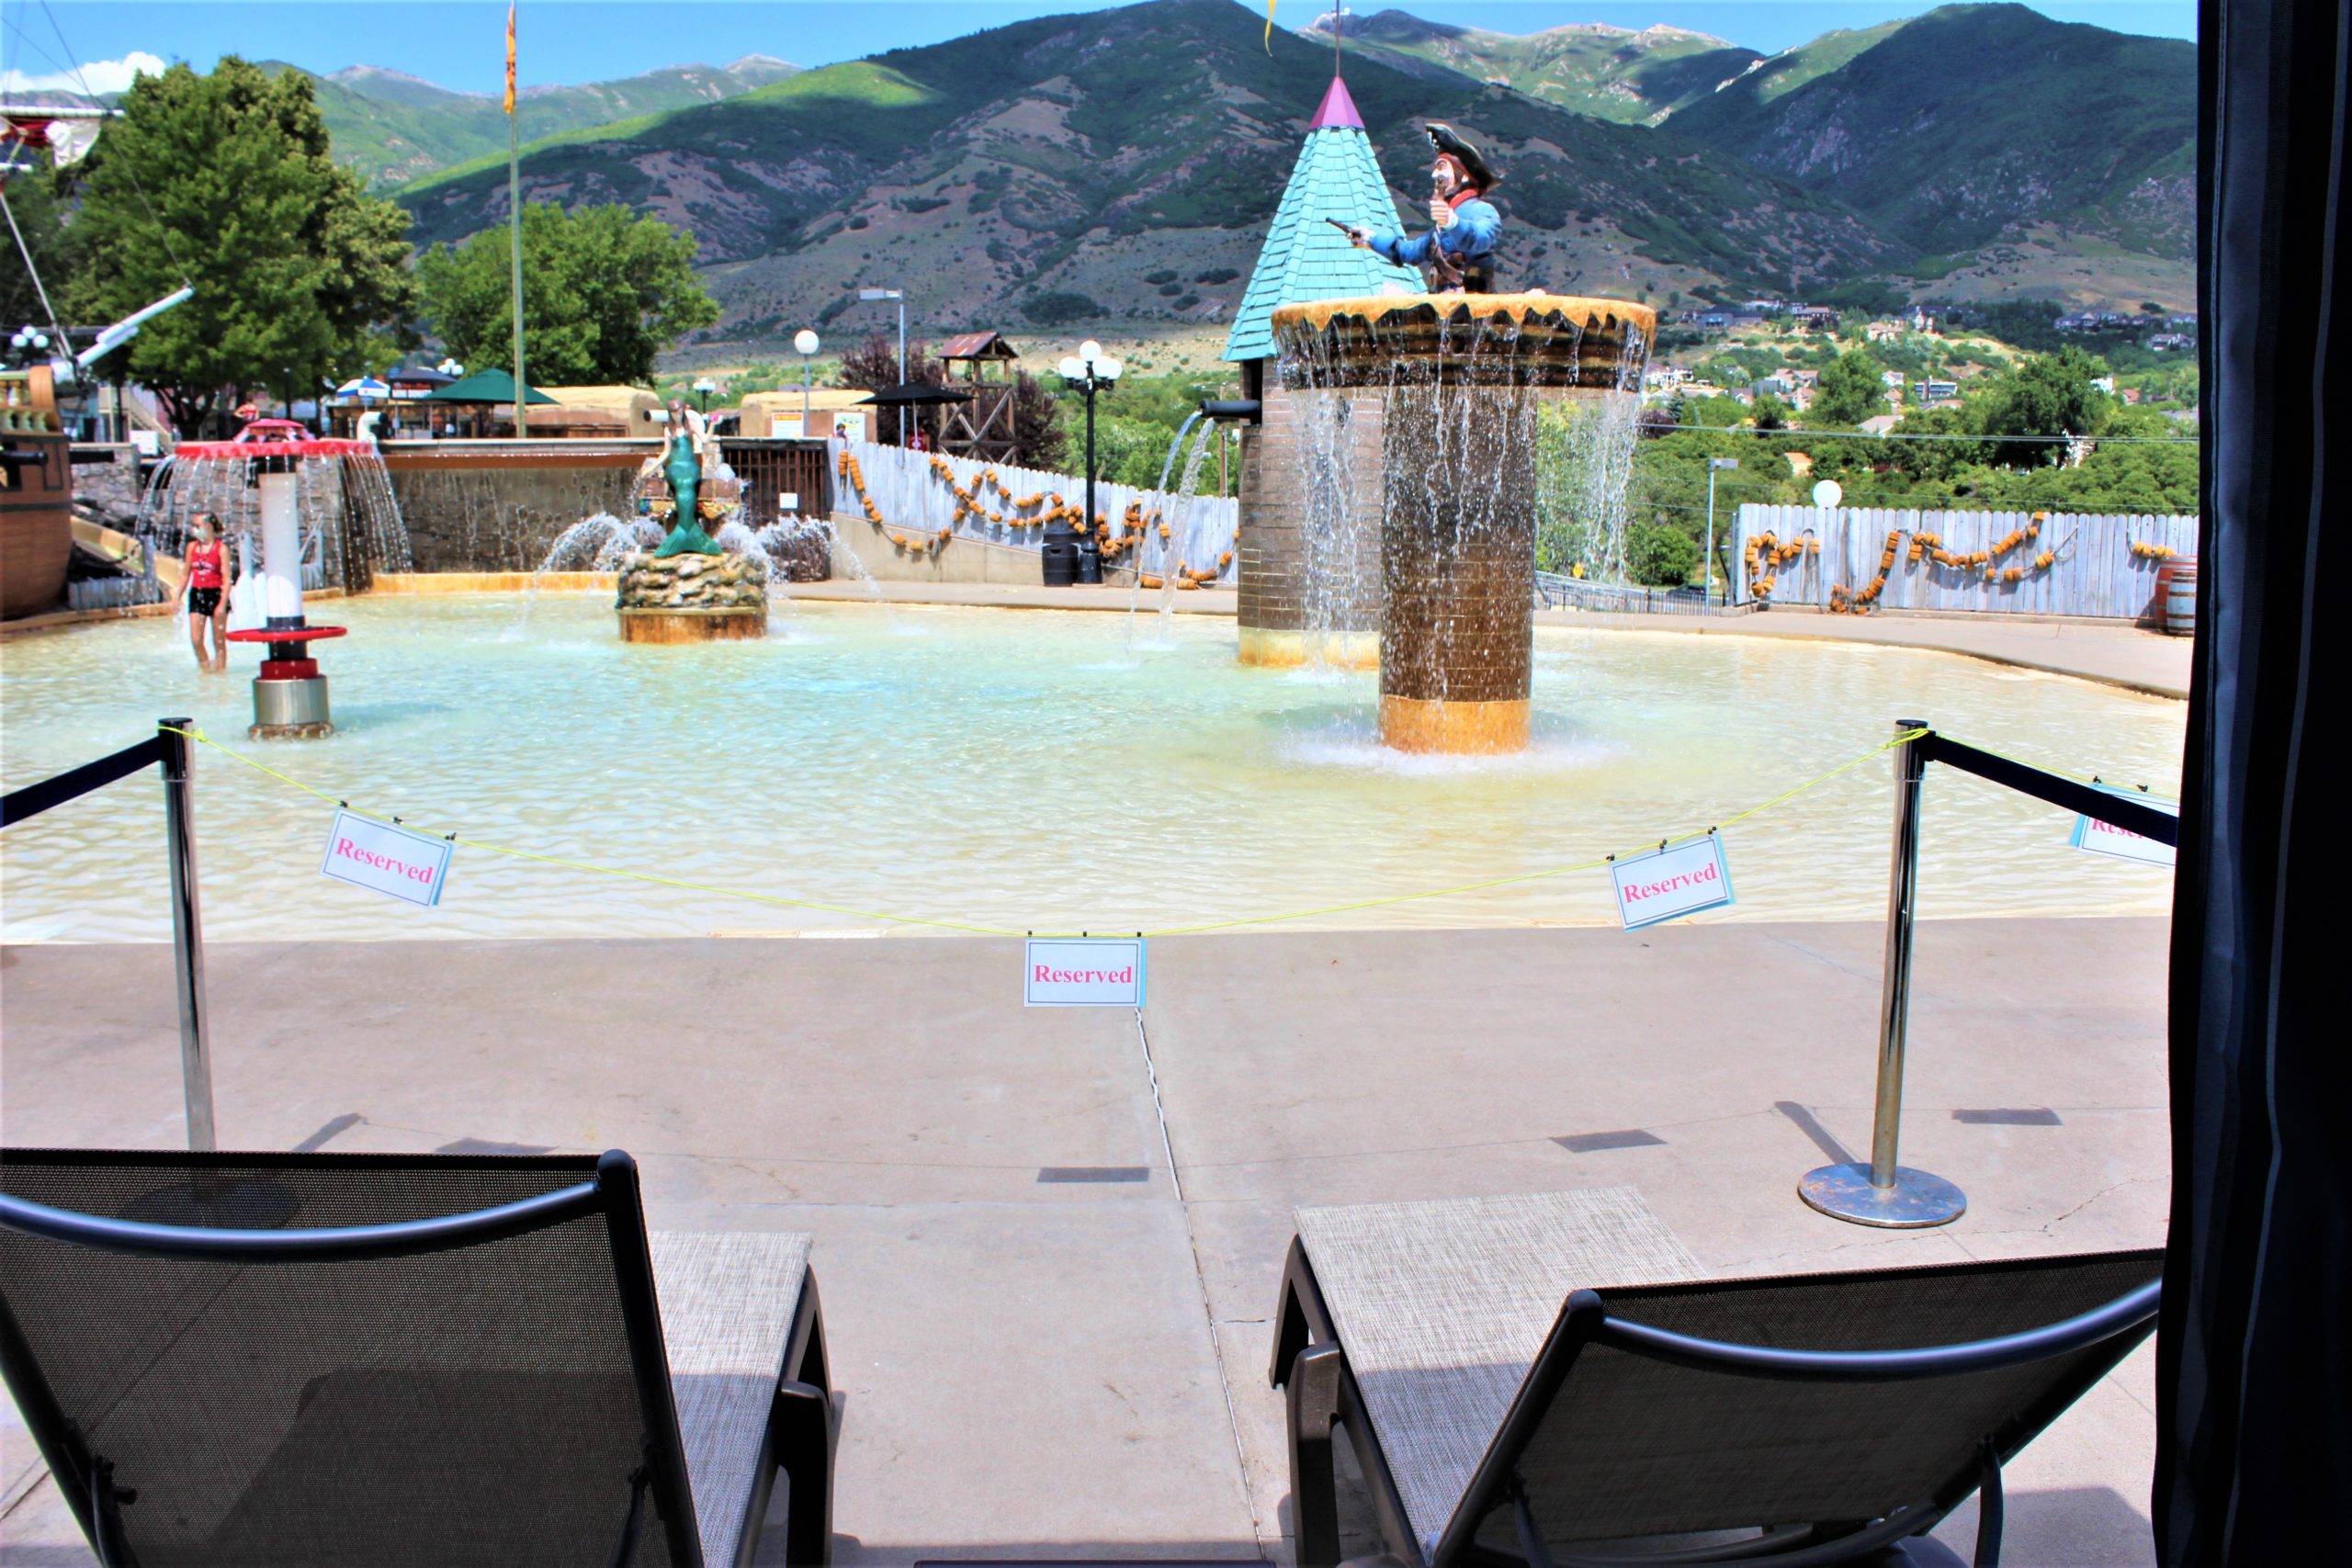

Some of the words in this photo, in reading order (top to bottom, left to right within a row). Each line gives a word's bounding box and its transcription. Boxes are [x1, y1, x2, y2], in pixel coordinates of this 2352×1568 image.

[335, 837, 435, 884] Reserved
[1623, 862, 1718, 904] Reserved
[1034, 964, 1133, 984] Reserved
